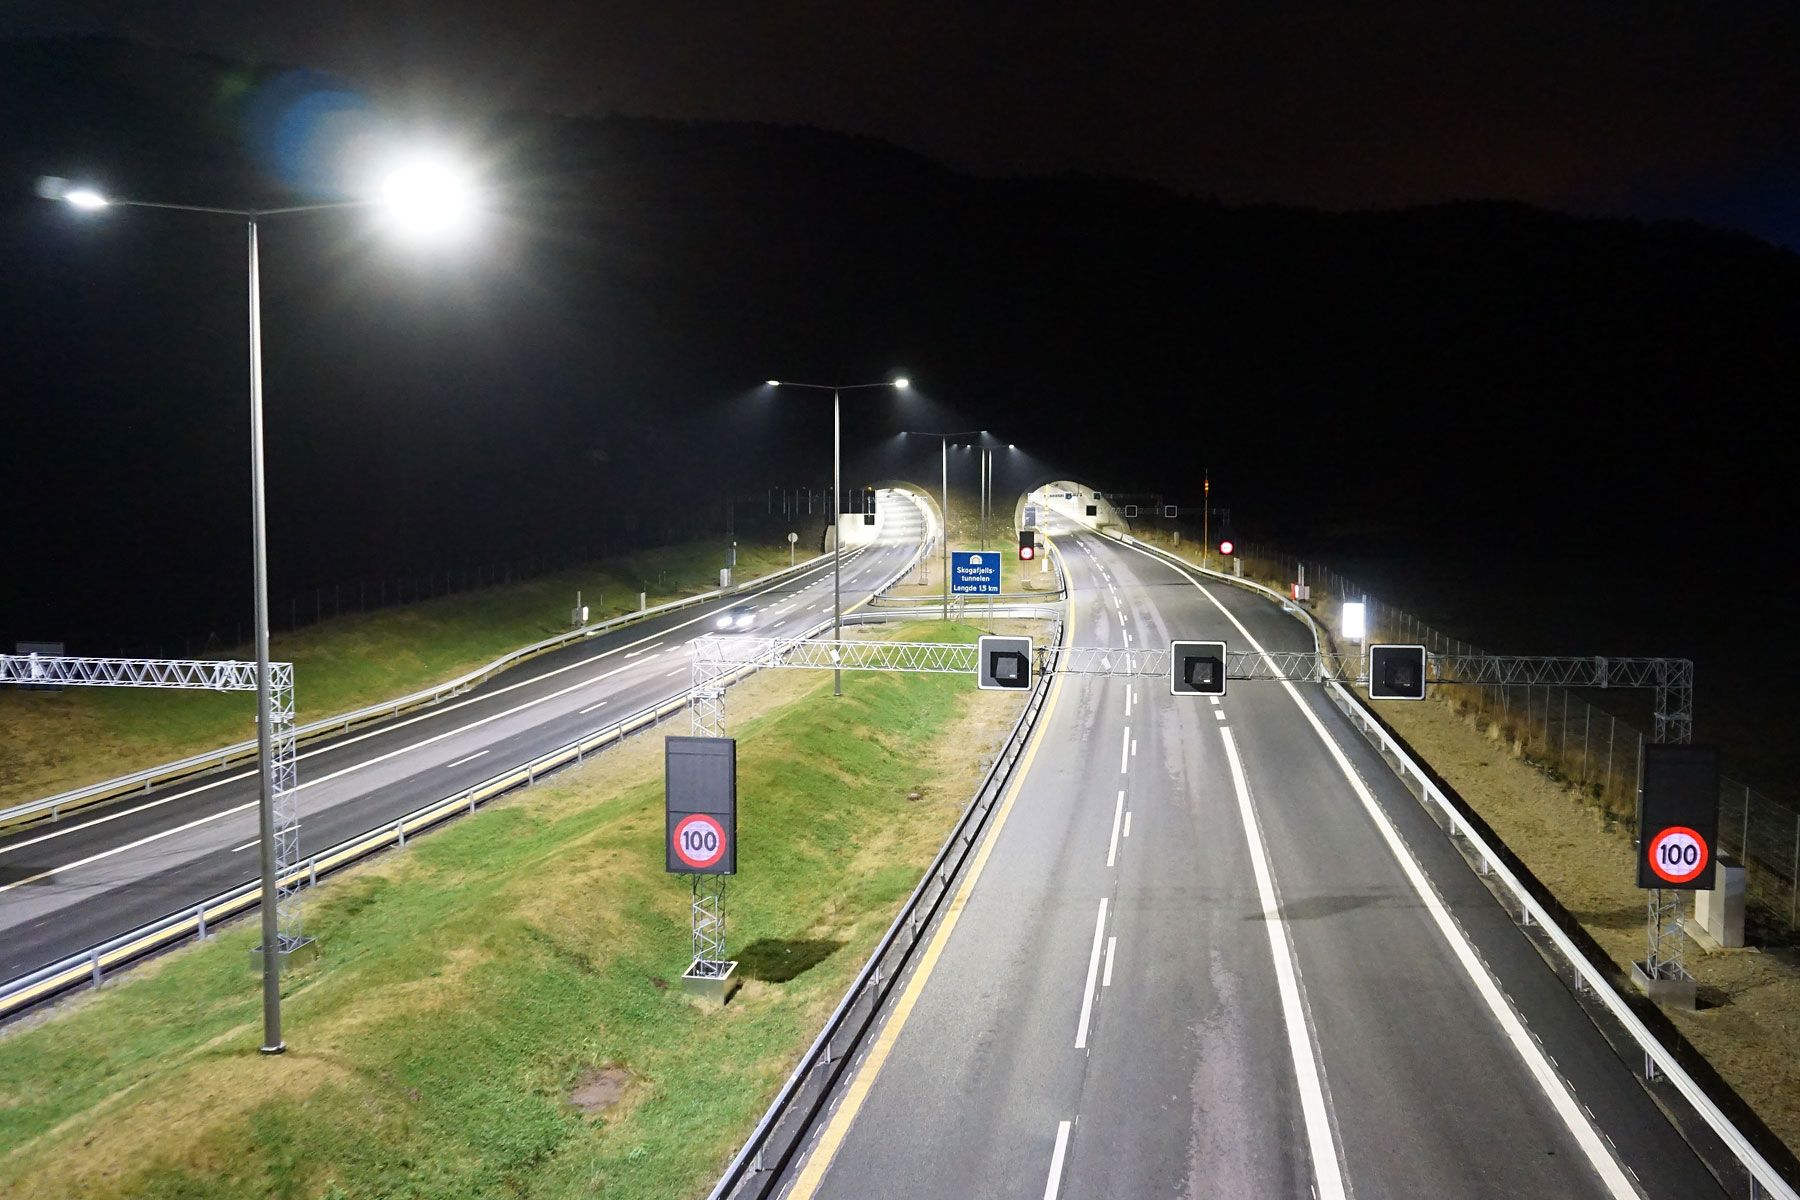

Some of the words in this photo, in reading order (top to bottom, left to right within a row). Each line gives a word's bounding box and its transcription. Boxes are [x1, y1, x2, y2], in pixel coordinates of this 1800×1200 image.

[957, 566, 995, 575] Skogafjells-
[953, 584, 977, 592] Lengde
[988, 584, 998, 592] km
[683, 830, 717, 851] 100
[1660, 844, 1698, 865] 100
